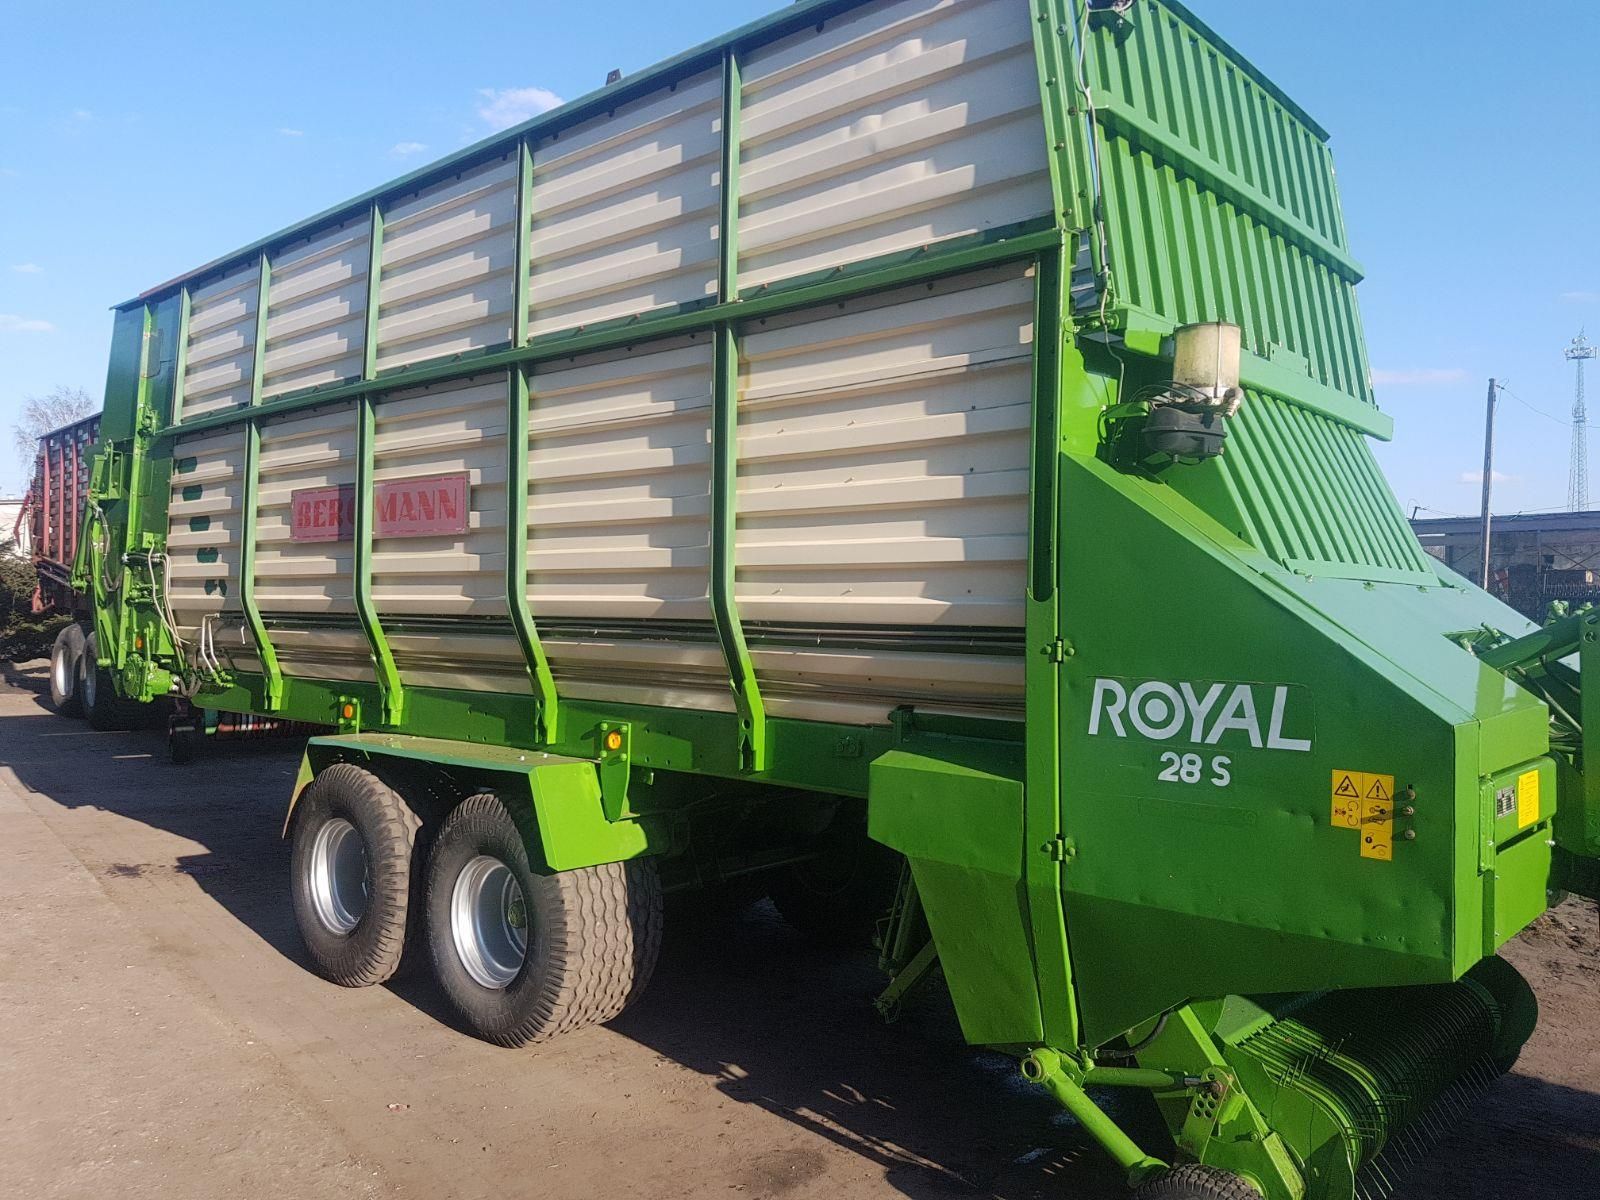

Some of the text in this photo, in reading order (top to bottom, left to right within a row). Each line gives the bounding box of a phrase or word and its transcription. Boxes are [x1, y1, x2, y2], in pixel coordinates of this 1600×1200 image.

[1088, 678, 1311, 751] ROYAL
[1157, 751, 1231, 787] 28 S
